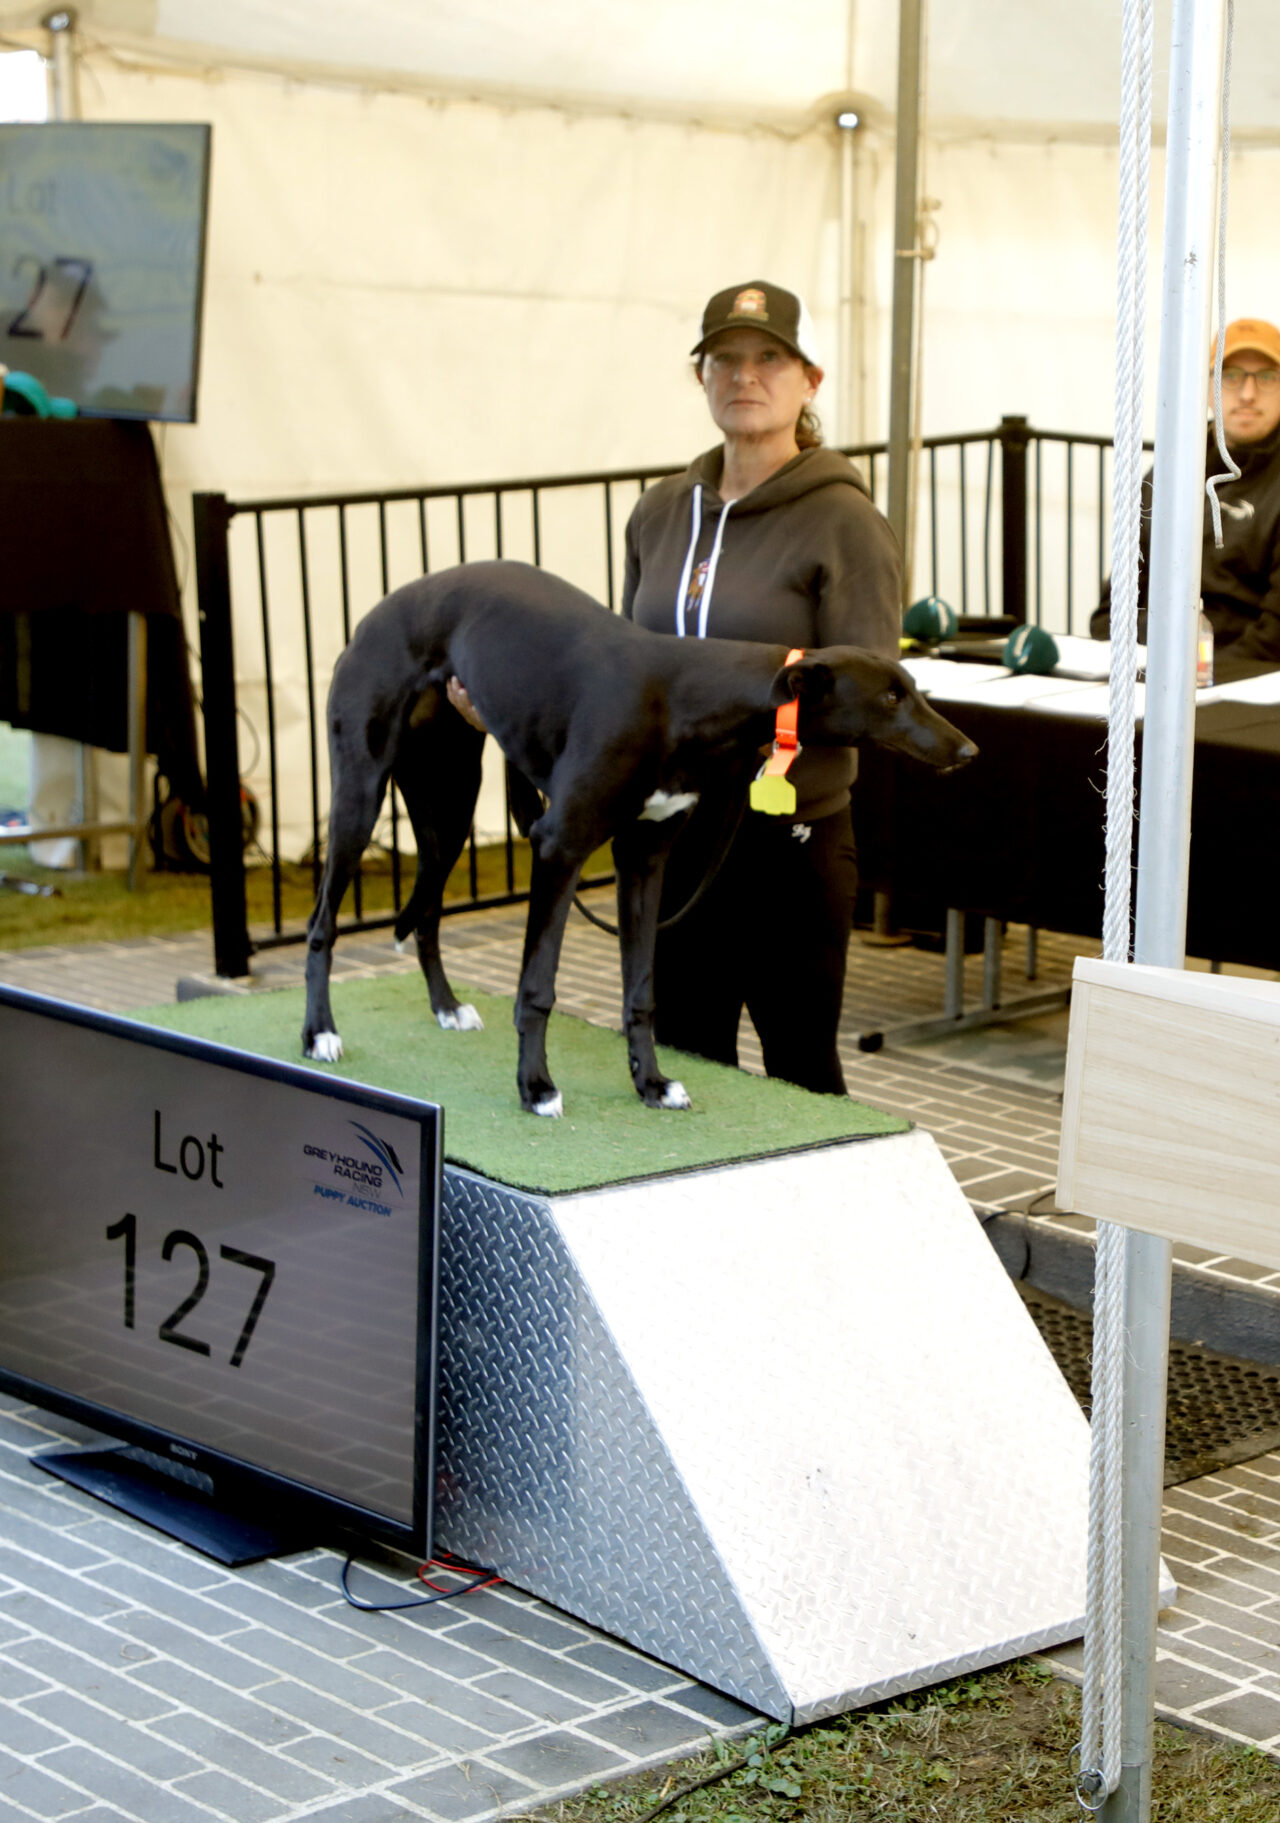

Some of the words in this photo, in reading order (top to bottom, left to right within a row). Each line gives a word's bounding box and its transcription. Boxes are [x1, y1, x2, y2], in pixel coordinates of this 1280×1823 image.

[154, 1110, 224, 1188] Lot
[304, 1145, 383, 1176] GREYHOUND
[334, 1165, 383, 1188] RACING
[347, 1196, 392, 1217] AUCTION
[106, 1212, 276, 1368] 127
